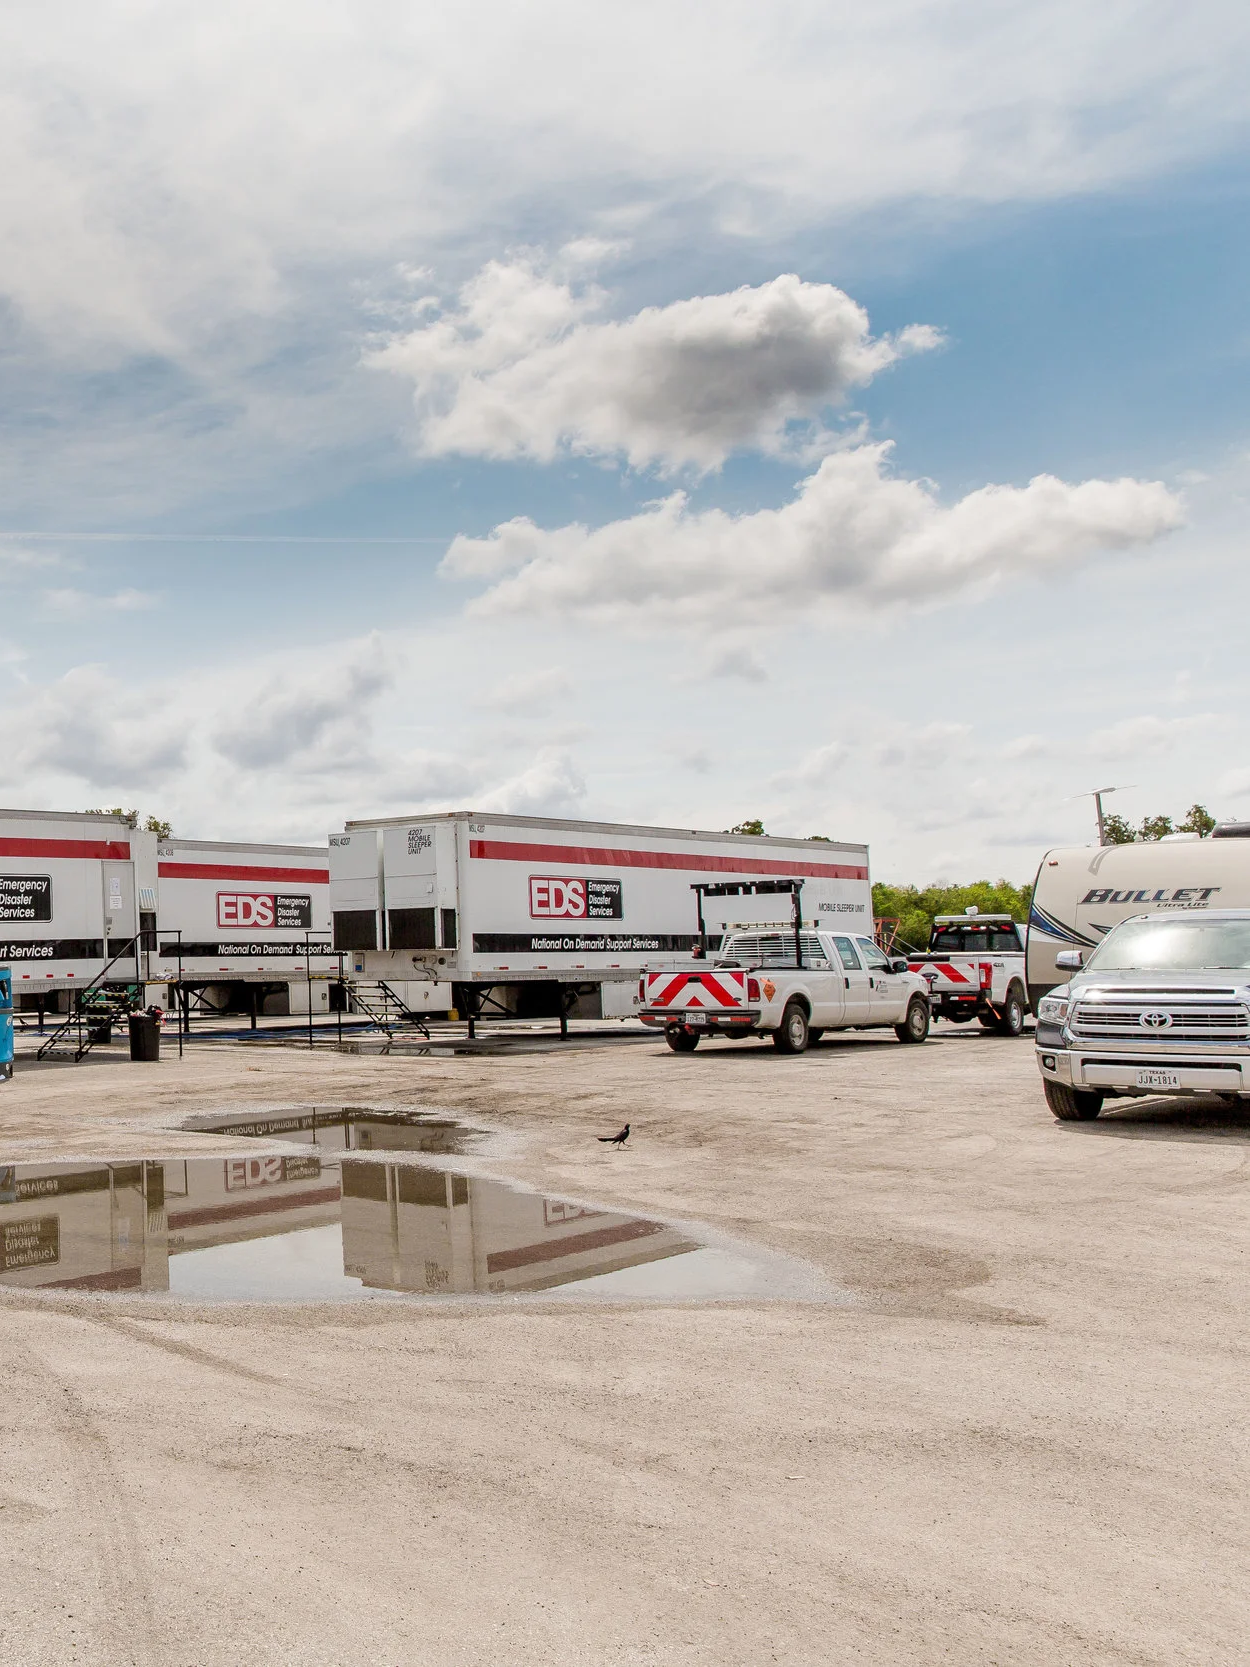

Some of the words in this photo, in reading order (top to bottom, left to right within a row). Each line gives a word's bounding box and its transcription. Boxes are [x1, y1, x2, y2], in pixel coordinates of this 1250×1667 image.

[407, 834, 431, 842] MOBILE
[407, 841, 432, 849] SLEEPER
[588, 882, 620, 894] Emergency
[531, 880, 585, 917] EDS
[588, 895, 612, 905] Disaster
[1079, 887, 1223, 904] BULLET
[277, 896, 310, 908] Emergency
[219, 895, 274, 927] EDS
[277, 907, 300, 917] Disaster
[589, 906, 613, 917] Services
[818, 903, 836, 912] MOBILE
[836, 903, 855, 913] SLEEPER
[855, 904, 865, 913] UNIT
[277, 917, 302, 926] Services
[218, 944, 249, 954] National
[250, 944, 262, 954] On
[263, 944, 293, 954] Demand
[531, 938, 562, 950] National
[563, 938, 574, 950] On
[575, 938, 605, 950] Demand
[606, 939, 632, 951] Support
[632, 939, 659, 949] Services
[9, 945, 54, 958] Services
[1138, 1075, 1178, 1085] JJX-1814
